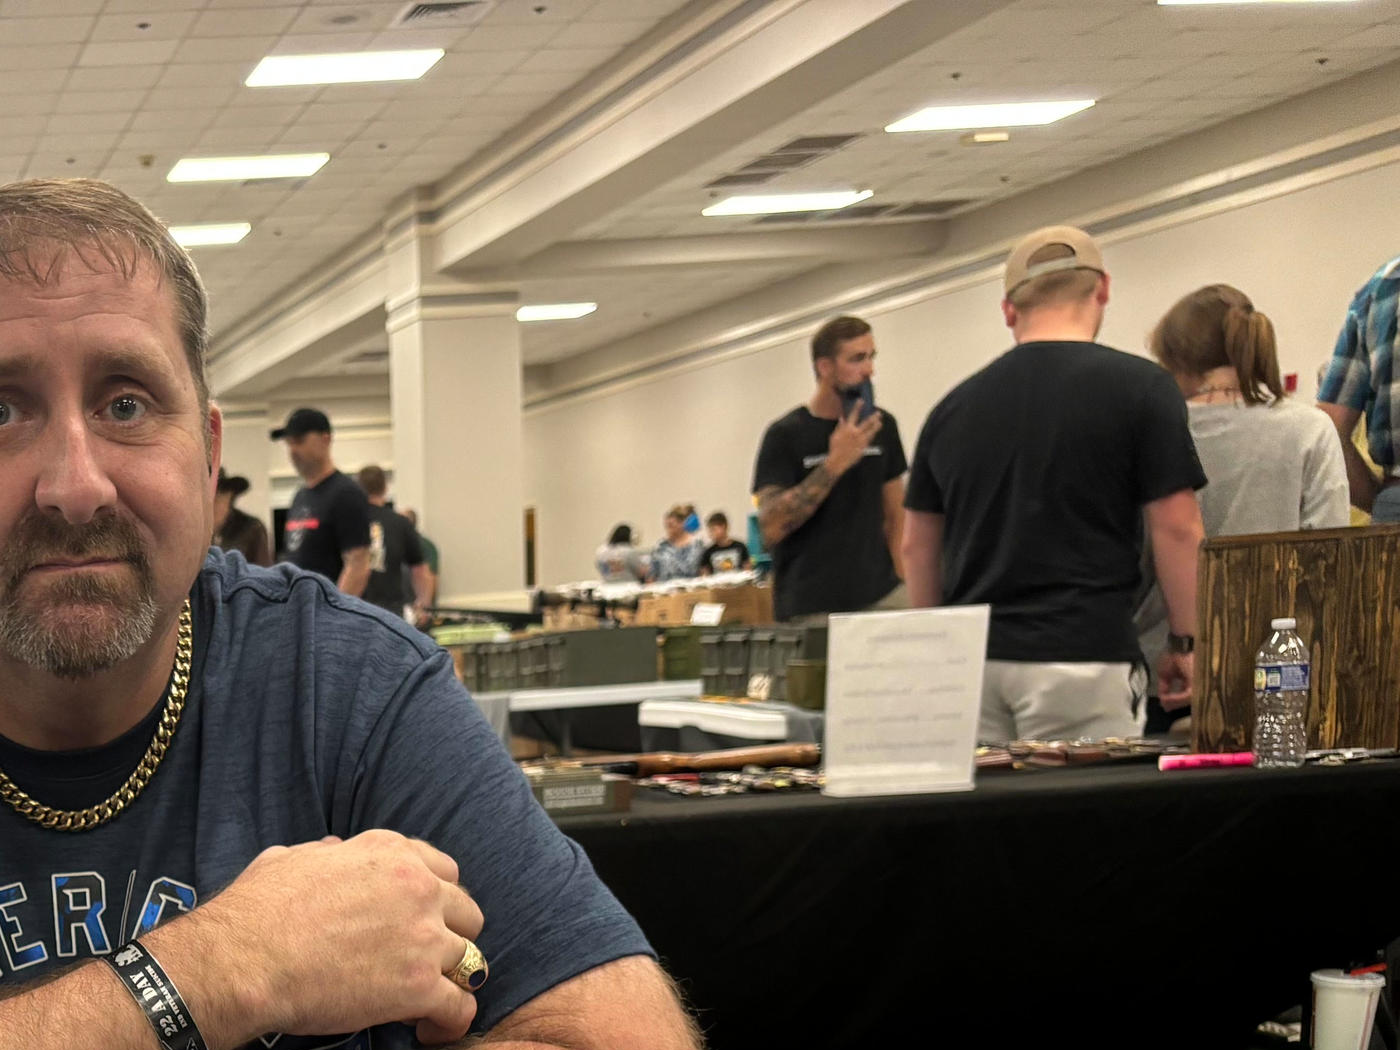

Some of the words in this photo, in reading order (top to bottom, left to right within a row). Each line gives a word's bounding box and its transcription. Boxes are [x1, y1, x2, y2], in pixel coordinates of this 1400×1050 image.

[129, 970, 159, 1002] DAY
[151, 999, 167, 1013] A
[159, 1014, 179, 1037] 22
